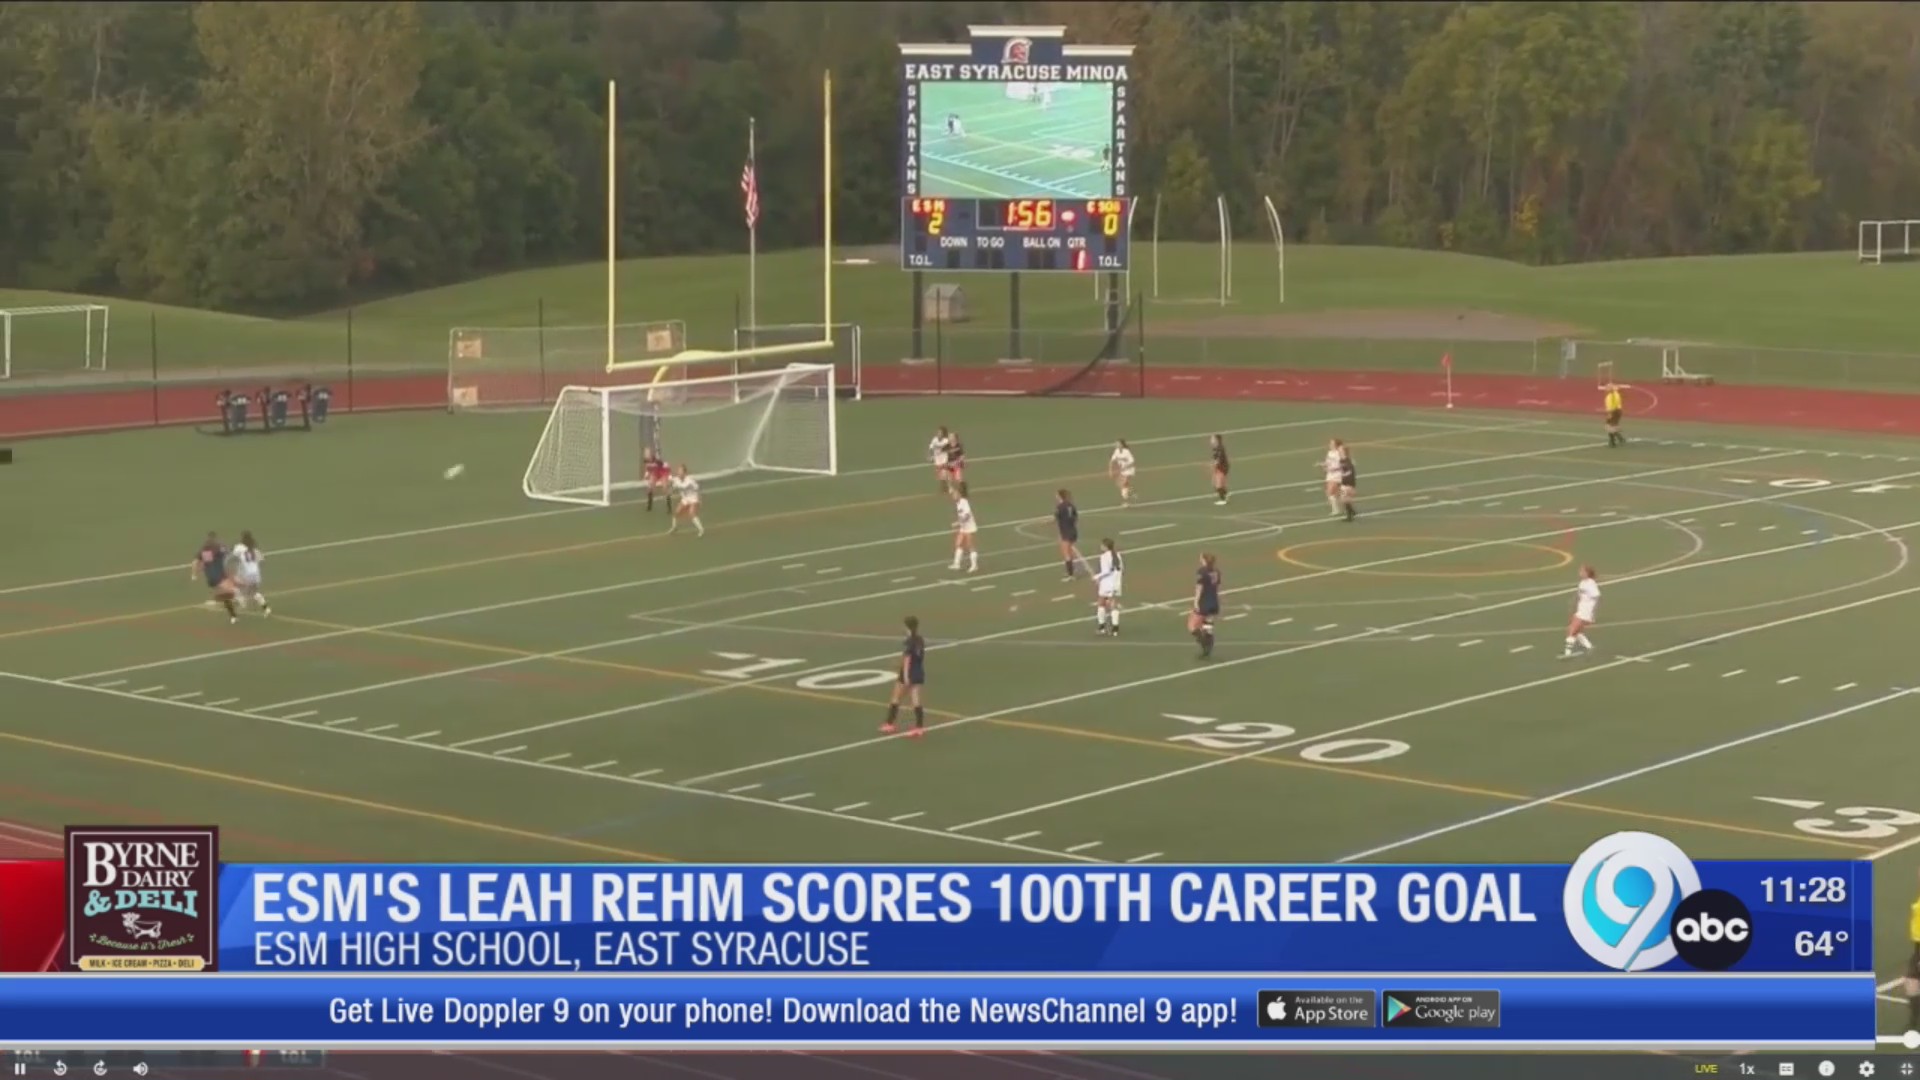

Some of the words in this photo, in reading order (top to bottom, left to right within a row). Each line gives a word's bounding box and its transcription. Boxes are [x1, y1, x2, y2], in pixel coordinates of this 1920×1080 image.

[905, 63, 955, 80] EAST
[959, 63, 1062, 81] SYRACUSE
[1066, 64, 1129, 81] MINOA
[907, 84, 917, 195] SPARTANS
[1115, 86, 1127, 195] SPARTANS
[1007, 200, 1052, 227] 1:56
[928, 213, 943, 234] 2
[1103, 213, 1118, 235] 0
[940, 236, 968, 248] DOWN
[976, 236, 989, 248] TO
[990, 236, 1005, 248] GO
[1022, 237, 1046, 248] BALL
[1047, 237, 1061, 248] ON
[1067, 237, 1087, 249] QTR
